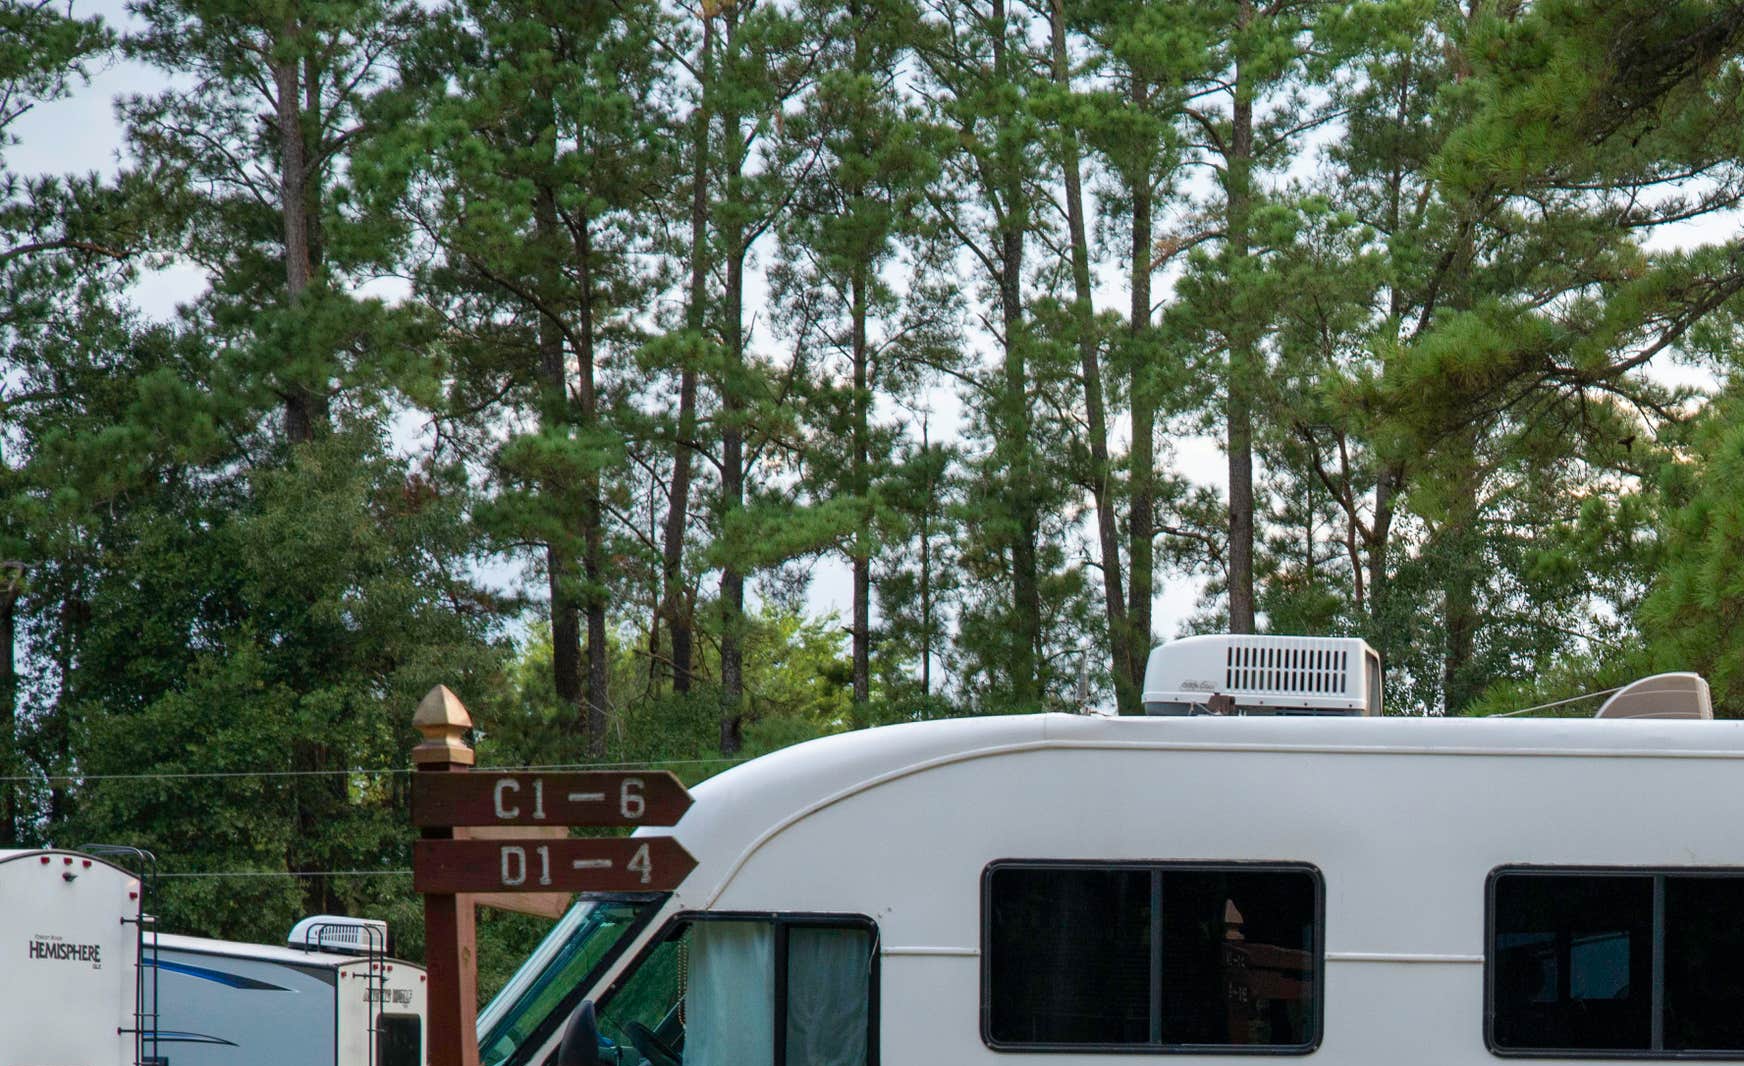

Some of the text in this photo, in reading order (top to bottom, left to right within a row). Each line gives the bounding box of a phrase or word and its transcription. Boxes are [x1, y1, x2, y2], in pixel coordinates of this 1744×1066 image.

[494, 778, 546, 819] C1
[620, 777, 646, 819] 6
[501, 845, 552, 886] D1
[626, 843, 652, 884] 4
[29, 940, 102, 963] HEMISPHERE
